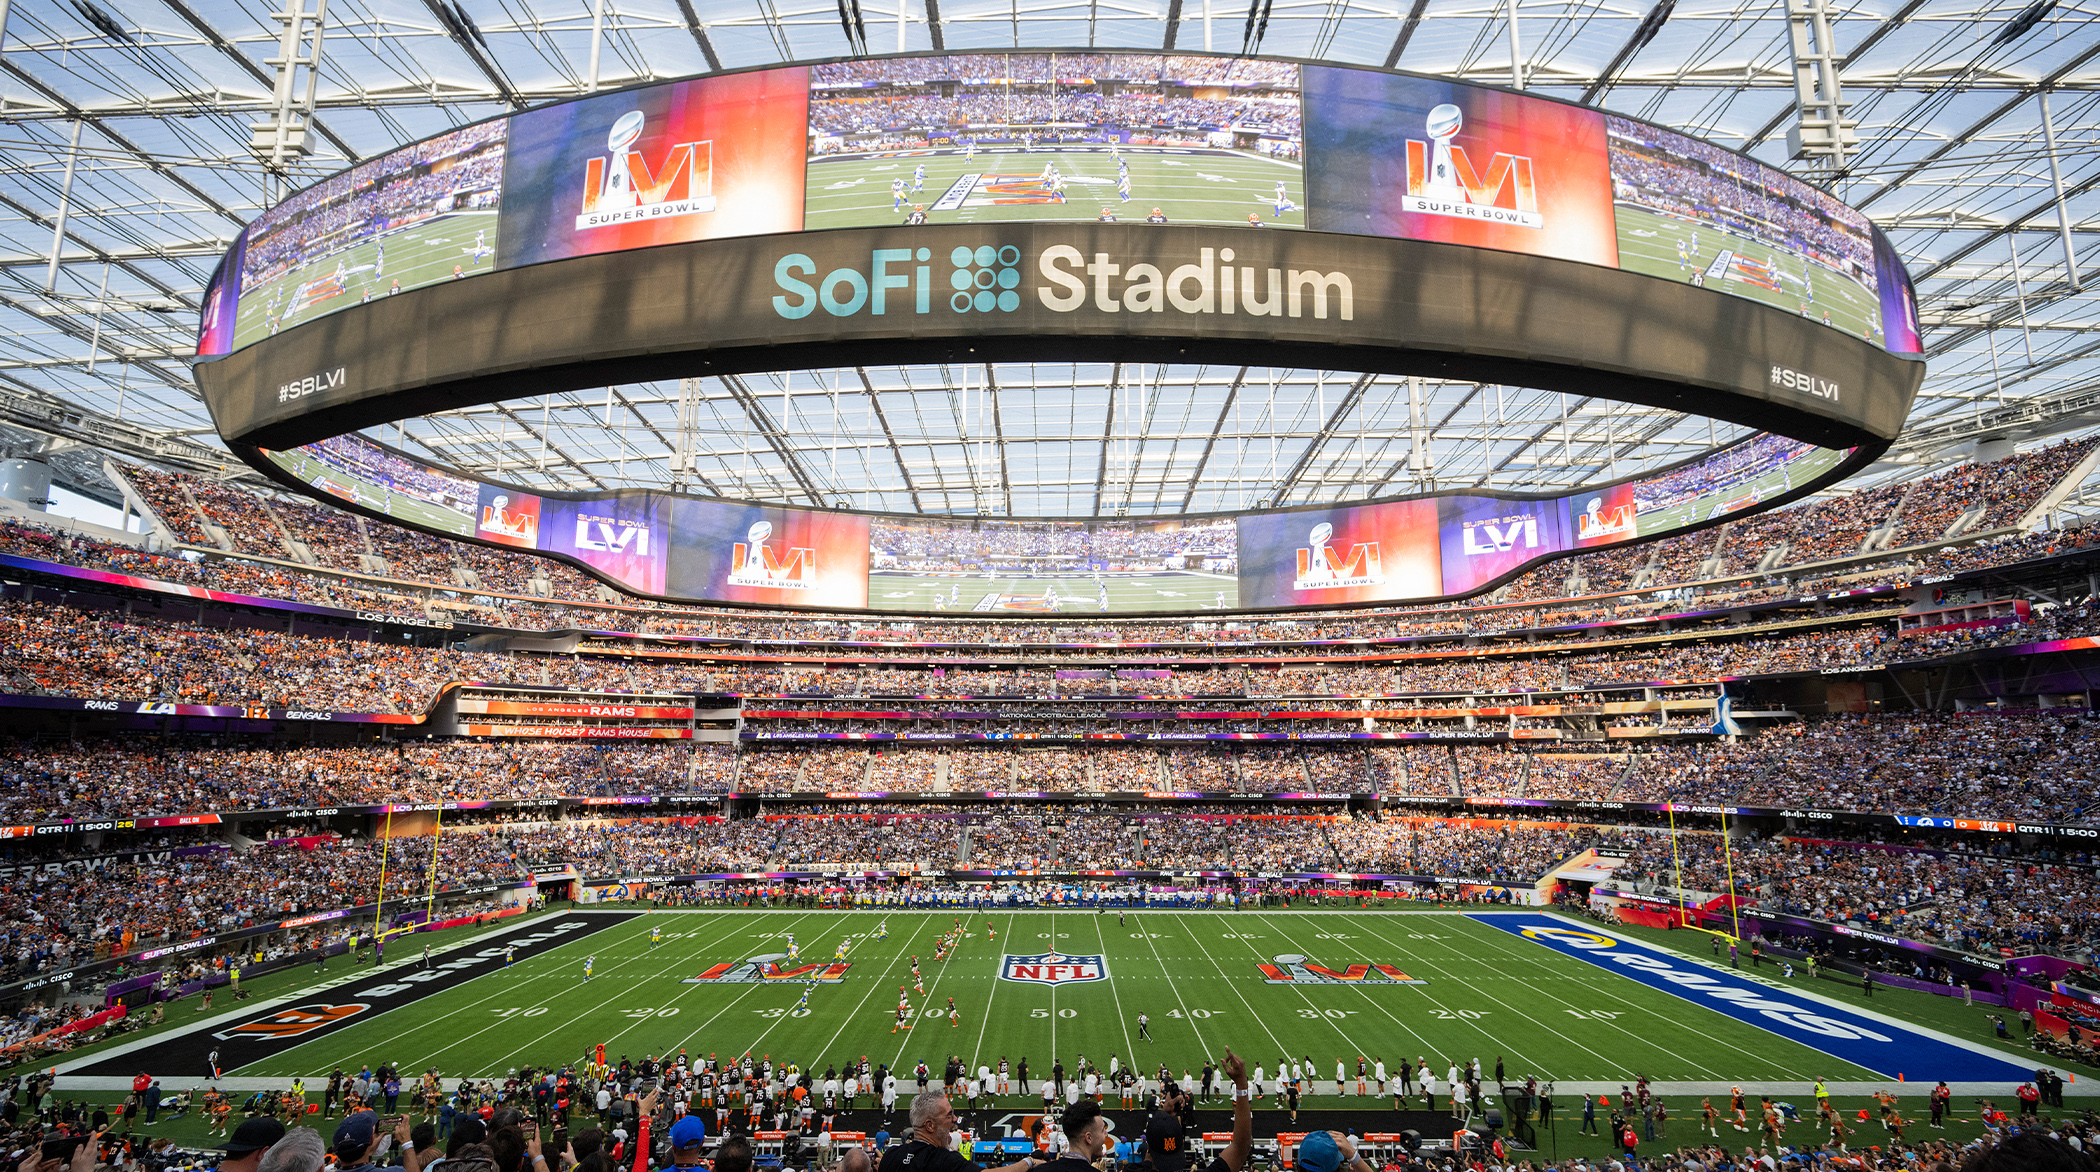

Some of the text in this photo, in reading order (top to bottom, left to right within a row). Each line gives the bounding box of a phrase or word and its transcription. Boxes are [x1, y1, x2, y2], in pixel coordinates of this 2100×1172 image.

[589, 202, 700, 226] SUPER BOWL
[1417, 200, 1529, 224] SUPER BOWL
[773, 244, 1353, 321] SoFi Stadium
[279, 367, 345, 402] #SBLVI
[1771, 366, 1838, 401] #SBLVI
[577, 513, 649, 529] SUPER BOWL
[1463, 513, 1536, 528] SUPER BOWL
[574, 519, 649, 556] LVI
[1463, 519, 1538, 555] LVI
[778, 580, 808, 588] BOWL
[1303, 578, 1375, 588] SUPER BOWL
[1922, 574, 1954, 585] BENGALS
[356, 611, 454, 629] LOS ANGELES
[1840, 664, 1886, 673] ANGELES
[84, 701, 118, 710] RAMS
[286, 711, 331, 720] BENGALS
[590, 707, 635, 716] RAMS
[505, 726, 653, 738] WHOSE HOUSE? RAMS HOUSE!
[315, 808, 338, 816] CISCO
[1691, 805, 1738, 815] ANGELES
[1808, 812, 1833, 820] CISCO
[37, 825, 63, 834] QTR
[79, 821, 112, 831] 15:00
[118, 820, 134, 829] 25
[2018, 825, 2042, 833] QTR
[2060, 828, 2098, 837] 15:00
[1619, 892, 1641, 900] SUPER
[1641, 894, 1660, 902] BOWL
[285, 910, 343, 928] LOS ANGELES
[1836, 926, 1899, 945] SUPER BOWL LVI
[143, 937, 216, 960] SUPER BOWL LVI
[353, 921, 588, 998] BENGALS
[1981, 961, 2000, 970] CISCO
[50, 972, 73, 983] CISCO
[1012, 965, 1096, 981] NFL
[1708, 964, 1793, 988] RACISM
[306, 969, 378, 990] TAKES
[1588, 950, 1893, 1042] RAMS
[494, 1007, 549, 1017] 10
[626, 1007, 680, 1018] 20
[762, 1008, 812, 1018] 30
[1030, 1008, 1077, 1018] 50
[1166, 1008, 1211, 1019] 40
[1297, 1008, 1346, 1019] 30
[1428, 1009, 1481, 1020] 20
[1563, 1009, 1616, 1020] 10
